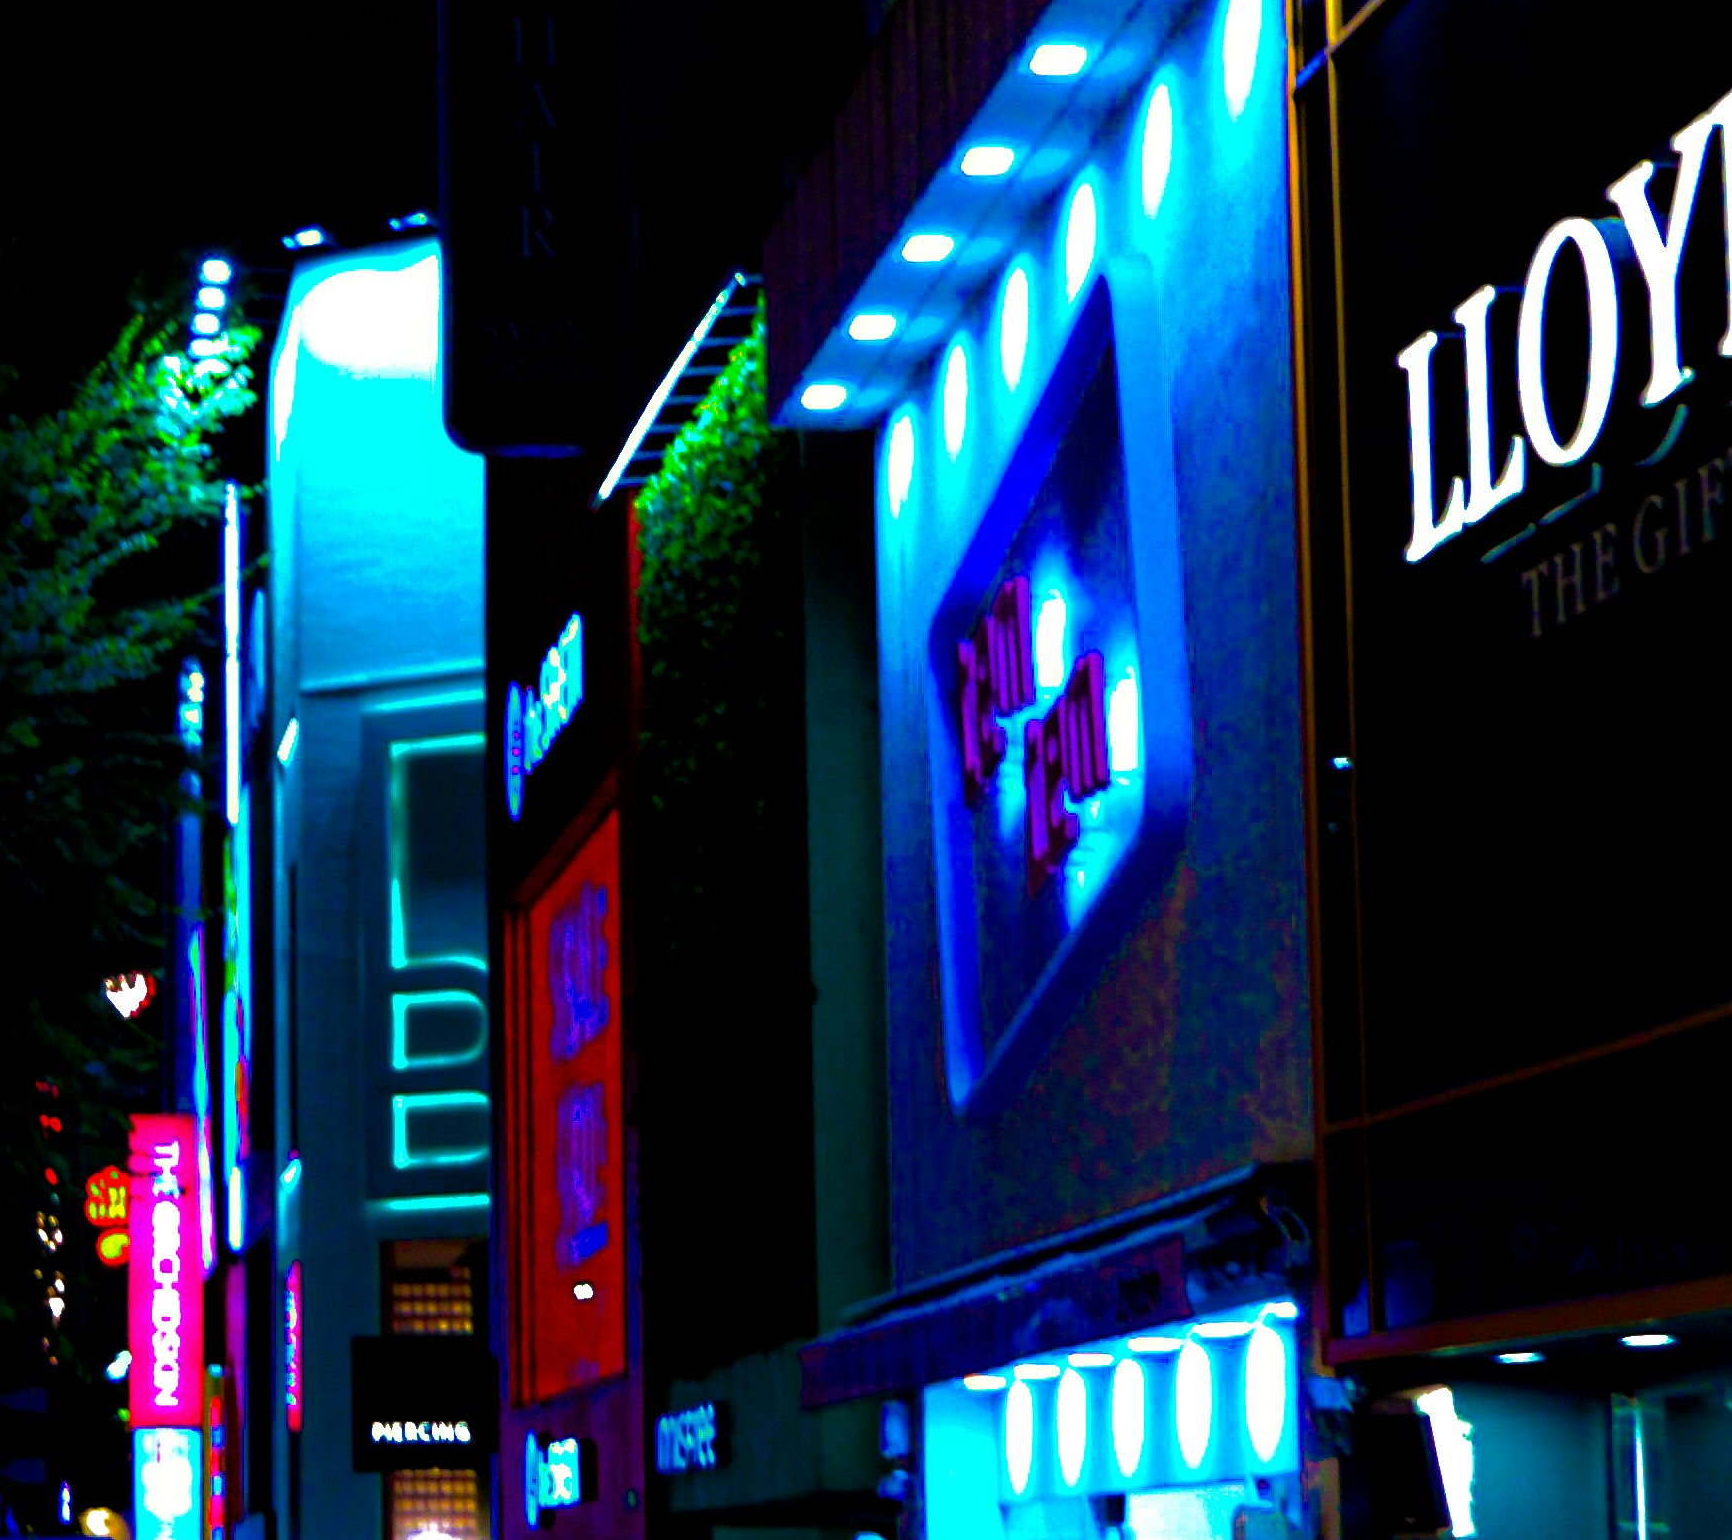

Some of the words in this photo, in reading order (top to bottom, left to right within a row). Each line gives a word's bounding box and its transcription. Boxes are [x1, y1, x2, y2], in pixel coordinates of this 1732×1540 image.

[1394, 85, 1732, 566] LLOY
[1520, 519, 1621, 642] THE
[1632, 448, 1732, 576] GIF
